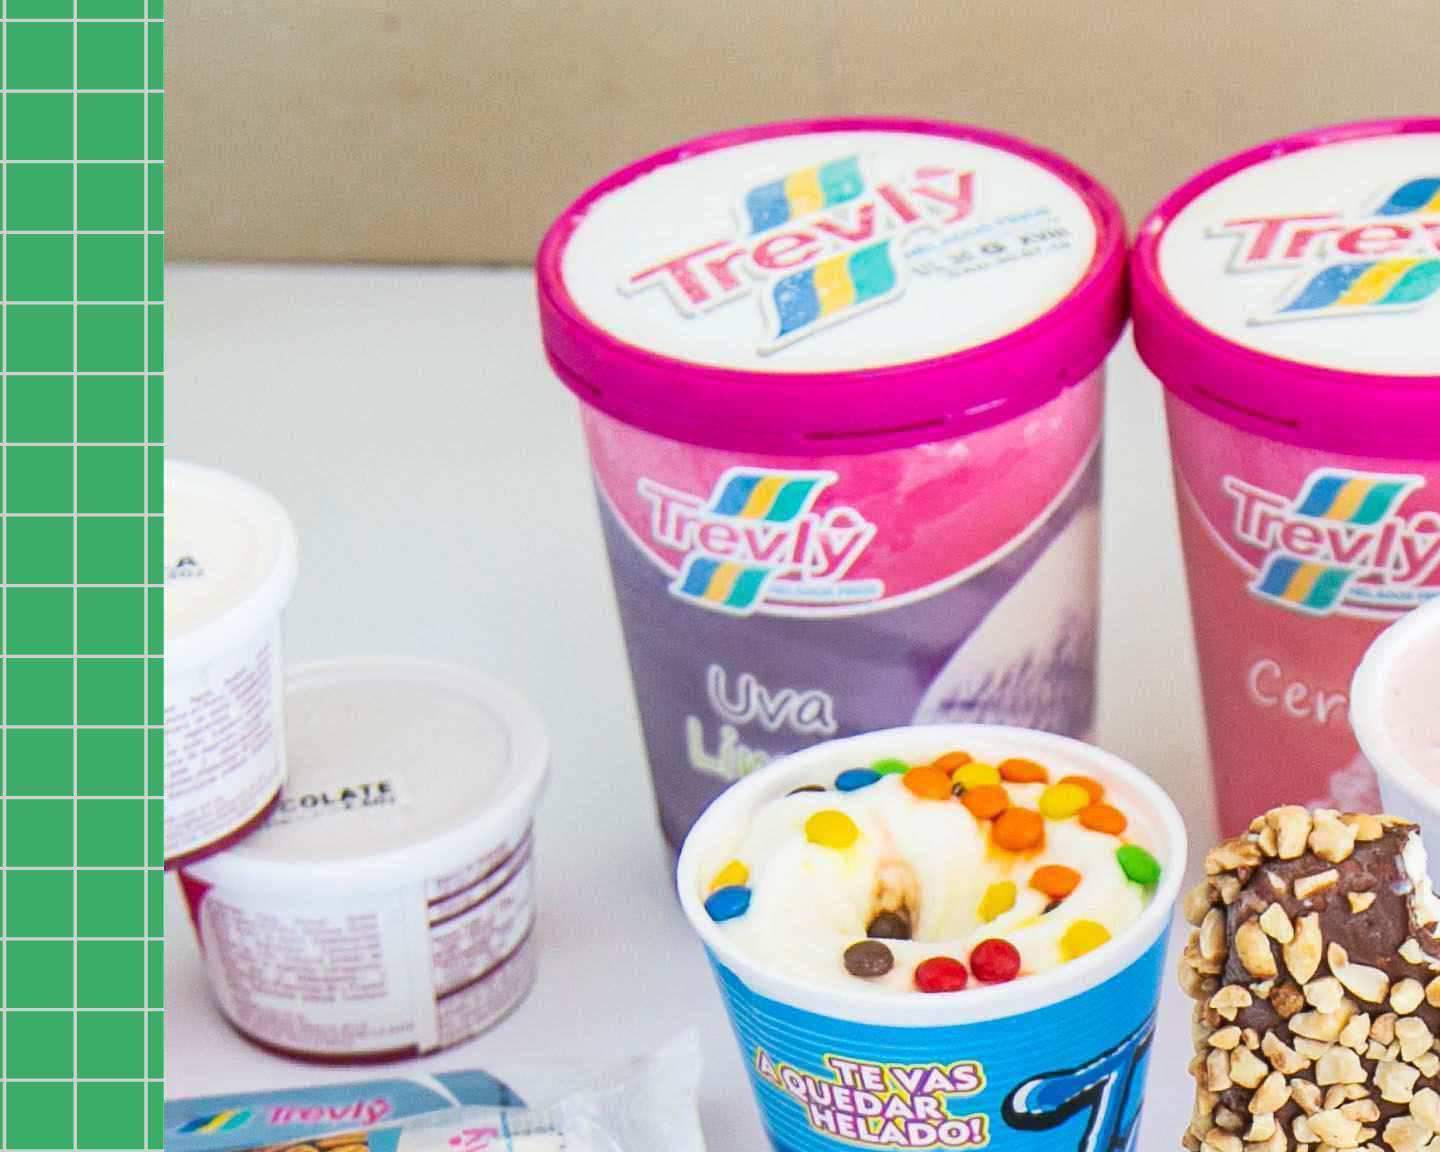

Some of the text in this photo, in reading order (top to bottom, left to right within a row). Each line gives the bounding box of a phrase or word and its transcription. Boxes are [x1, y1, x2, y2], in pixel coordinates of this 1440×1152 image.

[640, 478, 876, 580] Trevly
[708, 663, 838, 735] Uva
[1247, 657, 1348, 724] Cer
[757, 1048, 945, 1121] A QUEDAR
[828, 1056, 983, 1096] TE VAS
[808, 1102, 985, 1148] HELADO!
